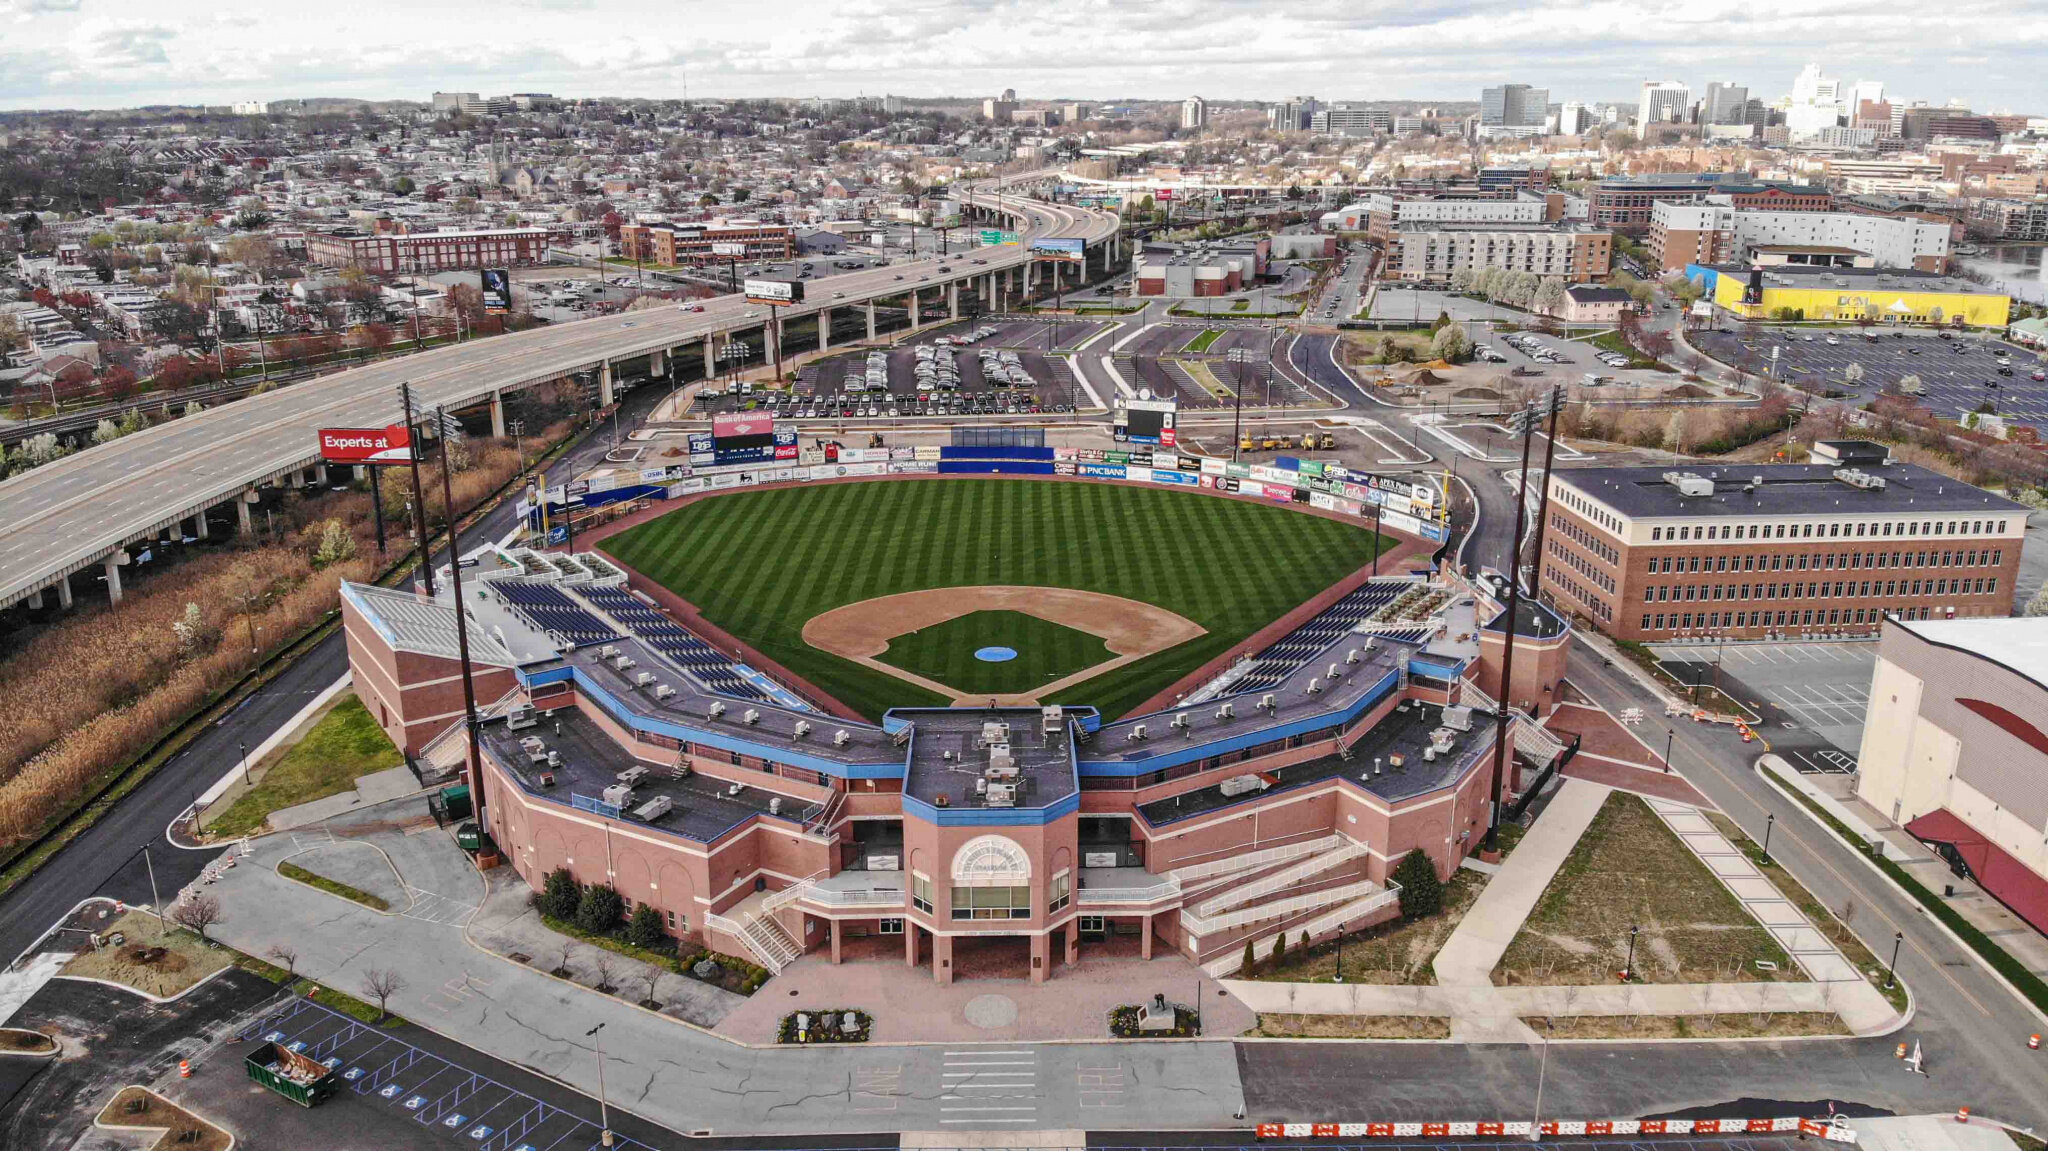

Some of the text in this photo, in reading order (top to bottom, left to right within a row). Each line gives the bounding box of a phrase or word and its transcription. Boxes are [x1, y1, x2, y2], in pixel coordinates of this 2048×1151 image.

[715, 415, 733, 424] Bank
[741, 414, 770, 422] America
[325, 436, 388, 450] Experts at
[1087, 467, 1125, 476] PNC BANK
[1379, 478, 1396, 487] APEX
